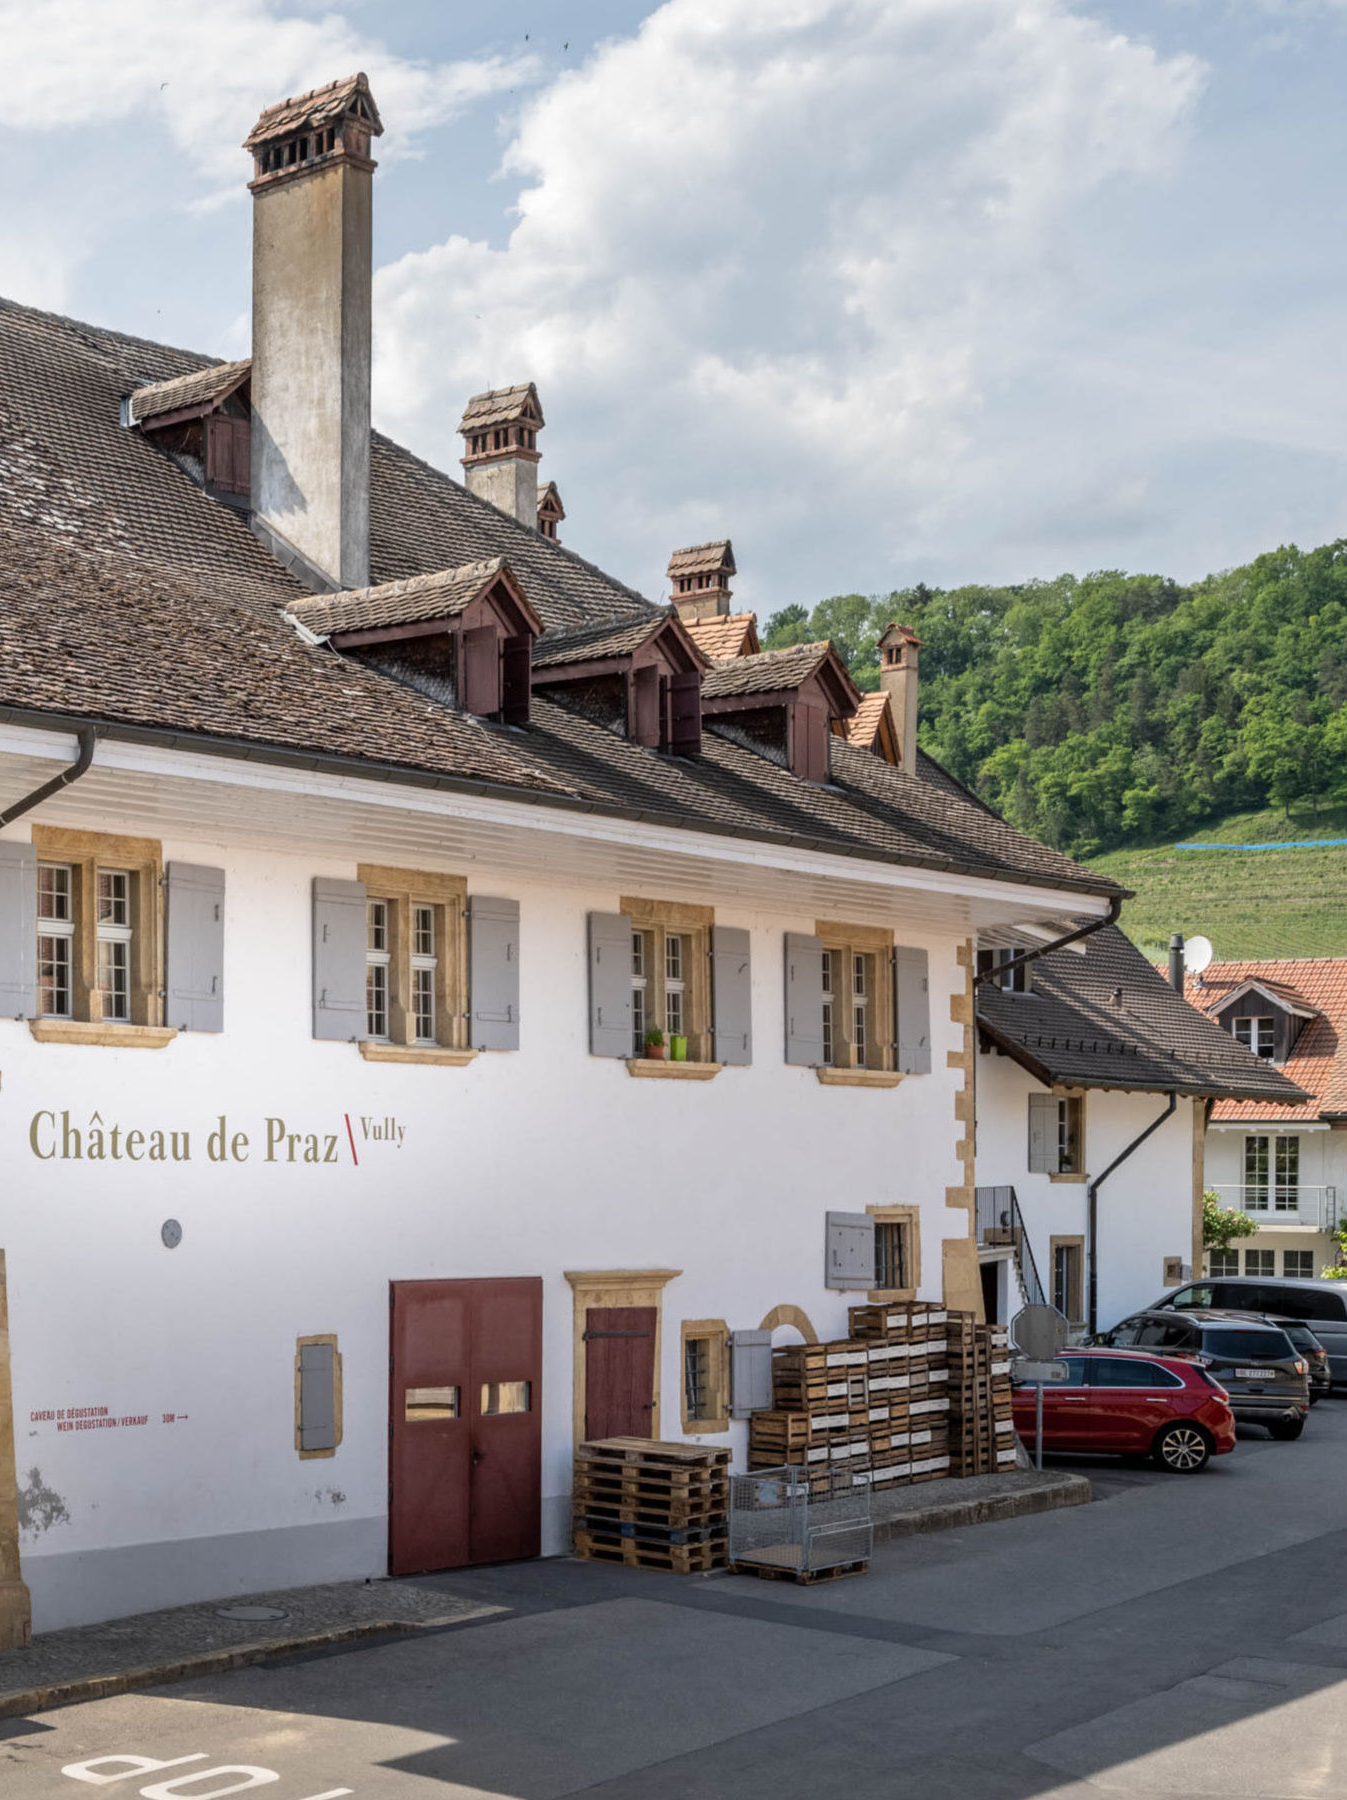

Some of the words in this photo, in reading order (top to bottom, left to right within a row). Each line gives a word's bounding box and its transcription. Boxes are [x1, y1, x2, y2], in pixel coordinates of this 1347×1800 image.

[29, 1109, 192, 1161] Château
[206, 1115, 250, 1162] de
[263, 1117, 339, 1163] Praz
[360, 1116, 407, 1149] Vully
[30, 1410, 55, 1422] CAVEAU
[56, 1409, 65, 1420] DE
[57, 1421, 74, 1431] WEIN
